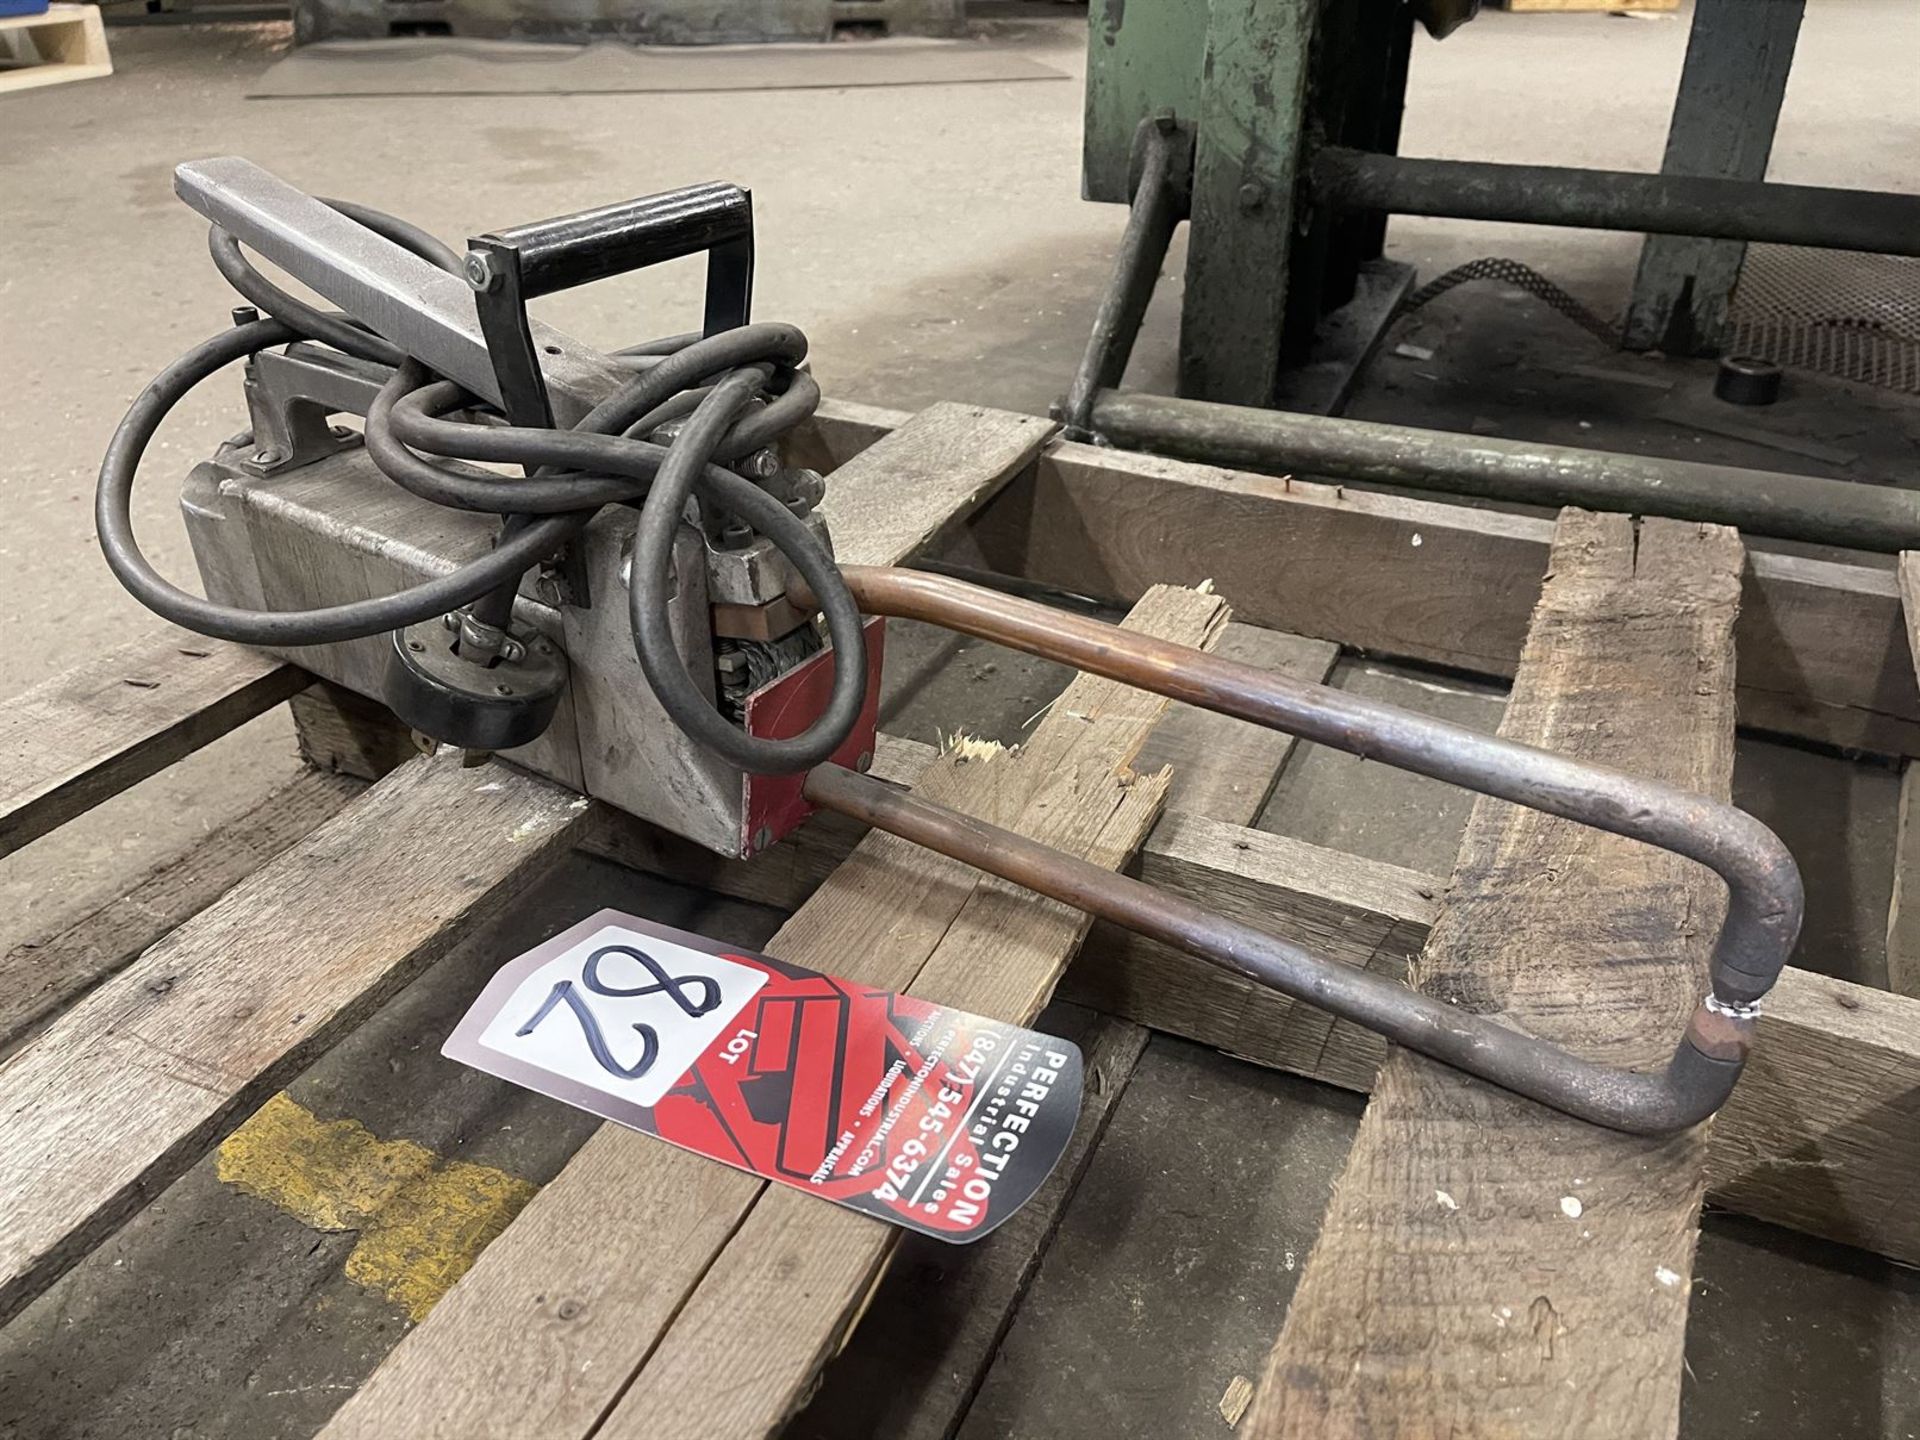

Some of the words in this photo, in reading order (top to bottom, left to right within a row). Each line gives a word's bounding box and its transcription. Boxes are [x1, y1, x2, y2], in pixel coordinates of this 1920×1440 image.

[515, 944, 723, 1081] 82
[909, 1010, 941, 1047] AUCTIONS
[719, 1028, 758, 1065] LOT
[945, 1029, 1001, 1084] (847)
[848, 1029, 956, 1176] PERFECTIONINDUSTRIAL.COM
[859, 1059, 907, 1117] LIQUIDATIONS
[968, 1043, 1041, 1146] Industrial
[809, 1130, 856, 1185] APPRAISALS
[872, 1087, 963, 1202] 545-6374
[947, 1050, 1068, 1225] PERFECTION
[924, 1153, 973, 1214] Sales
